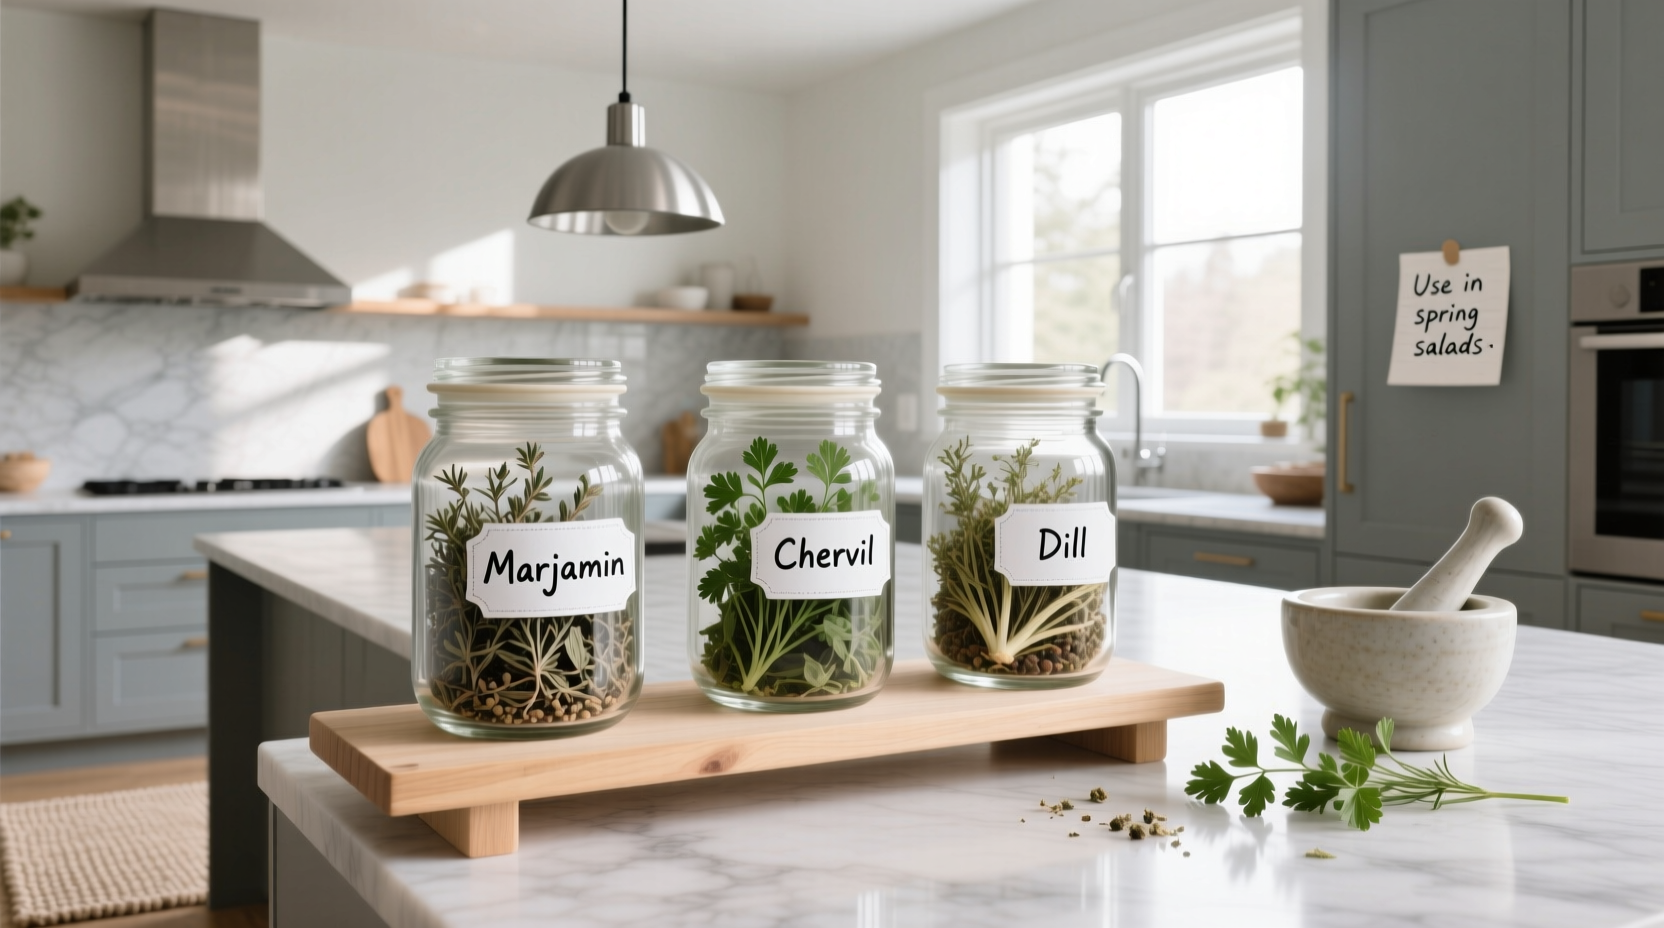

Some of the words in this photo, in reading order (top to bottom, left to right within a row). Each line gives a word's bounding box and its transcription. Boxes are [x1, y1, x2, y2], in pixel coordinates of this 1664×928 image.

[1413, 273, 1452, 296] Use
[1464, 273, 1483, 292] in
[1414, 303, 1479, 333] spring
[774, 534, 874, 571] Chervil
[1039, 526, 1087, 561] Dill
[483, 549, 625, 597] Marjamin
